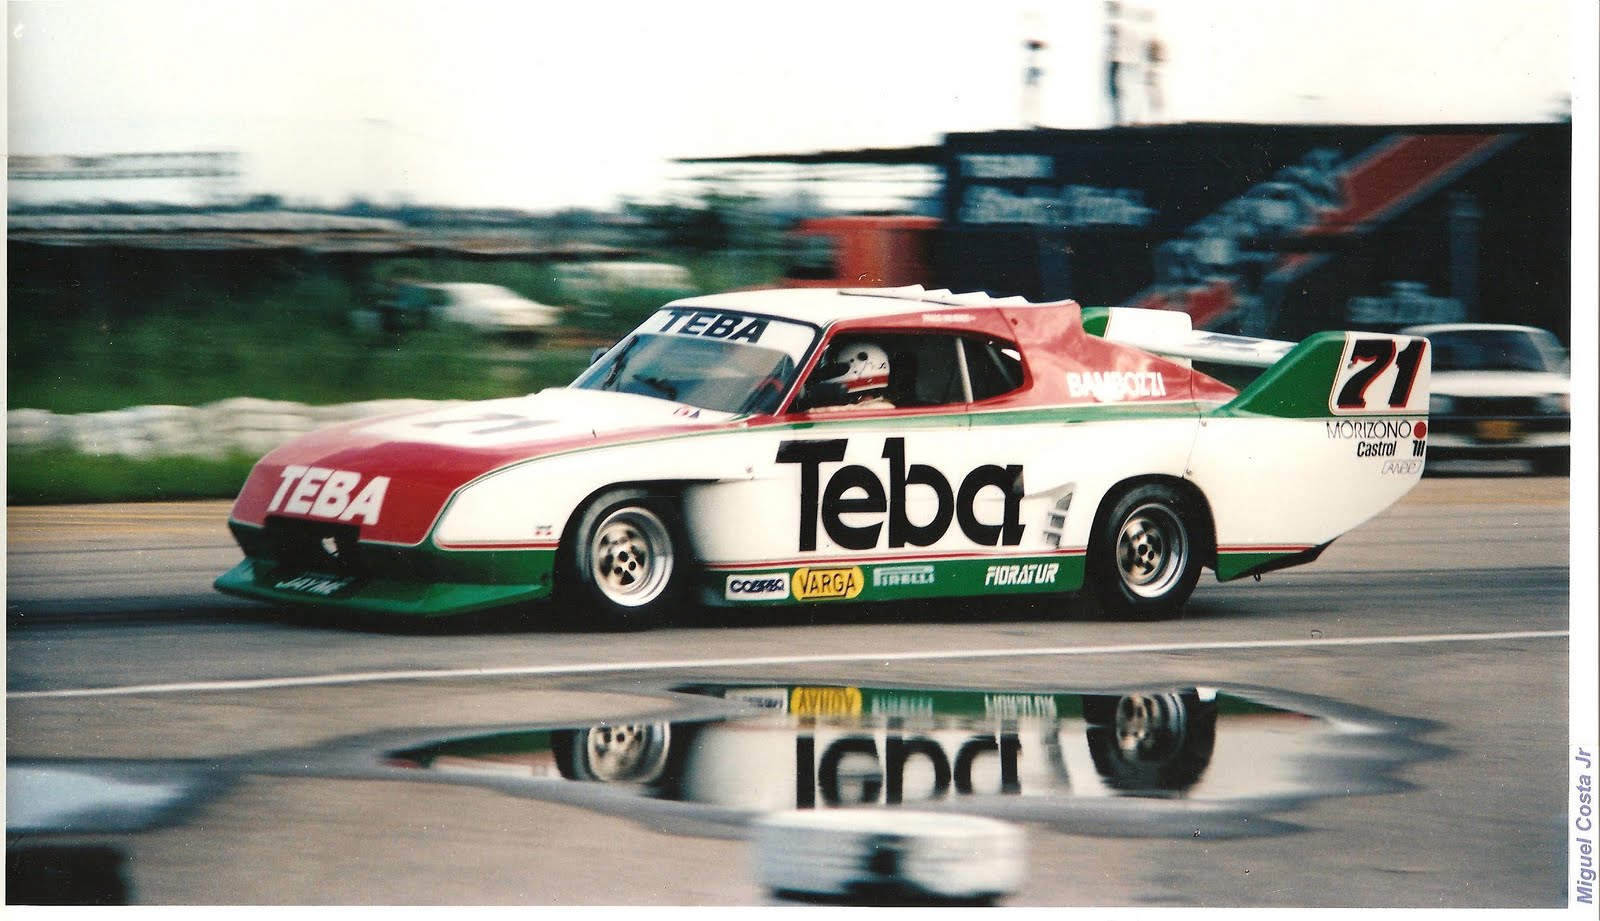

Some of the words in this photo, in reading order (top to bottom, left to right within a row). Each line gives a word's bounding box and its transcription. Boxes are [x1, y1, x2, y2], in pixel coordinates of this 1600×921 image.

[659, 311, 770, 343] TEBA
[1066, 371, 1167, 398] BAMBOZZI
[1337, 340, 1426, 408] 71
[1326, 420, 1411, 439] MORIZONO
[1357, 441, 1396, 457] Castrol
[267, 466, 391, 525] TEBA
[775, 437, 1026, 551] Teba
[799, 569, 857, 598] VARGA
[873, 565, 935, 587] PIRELLI
